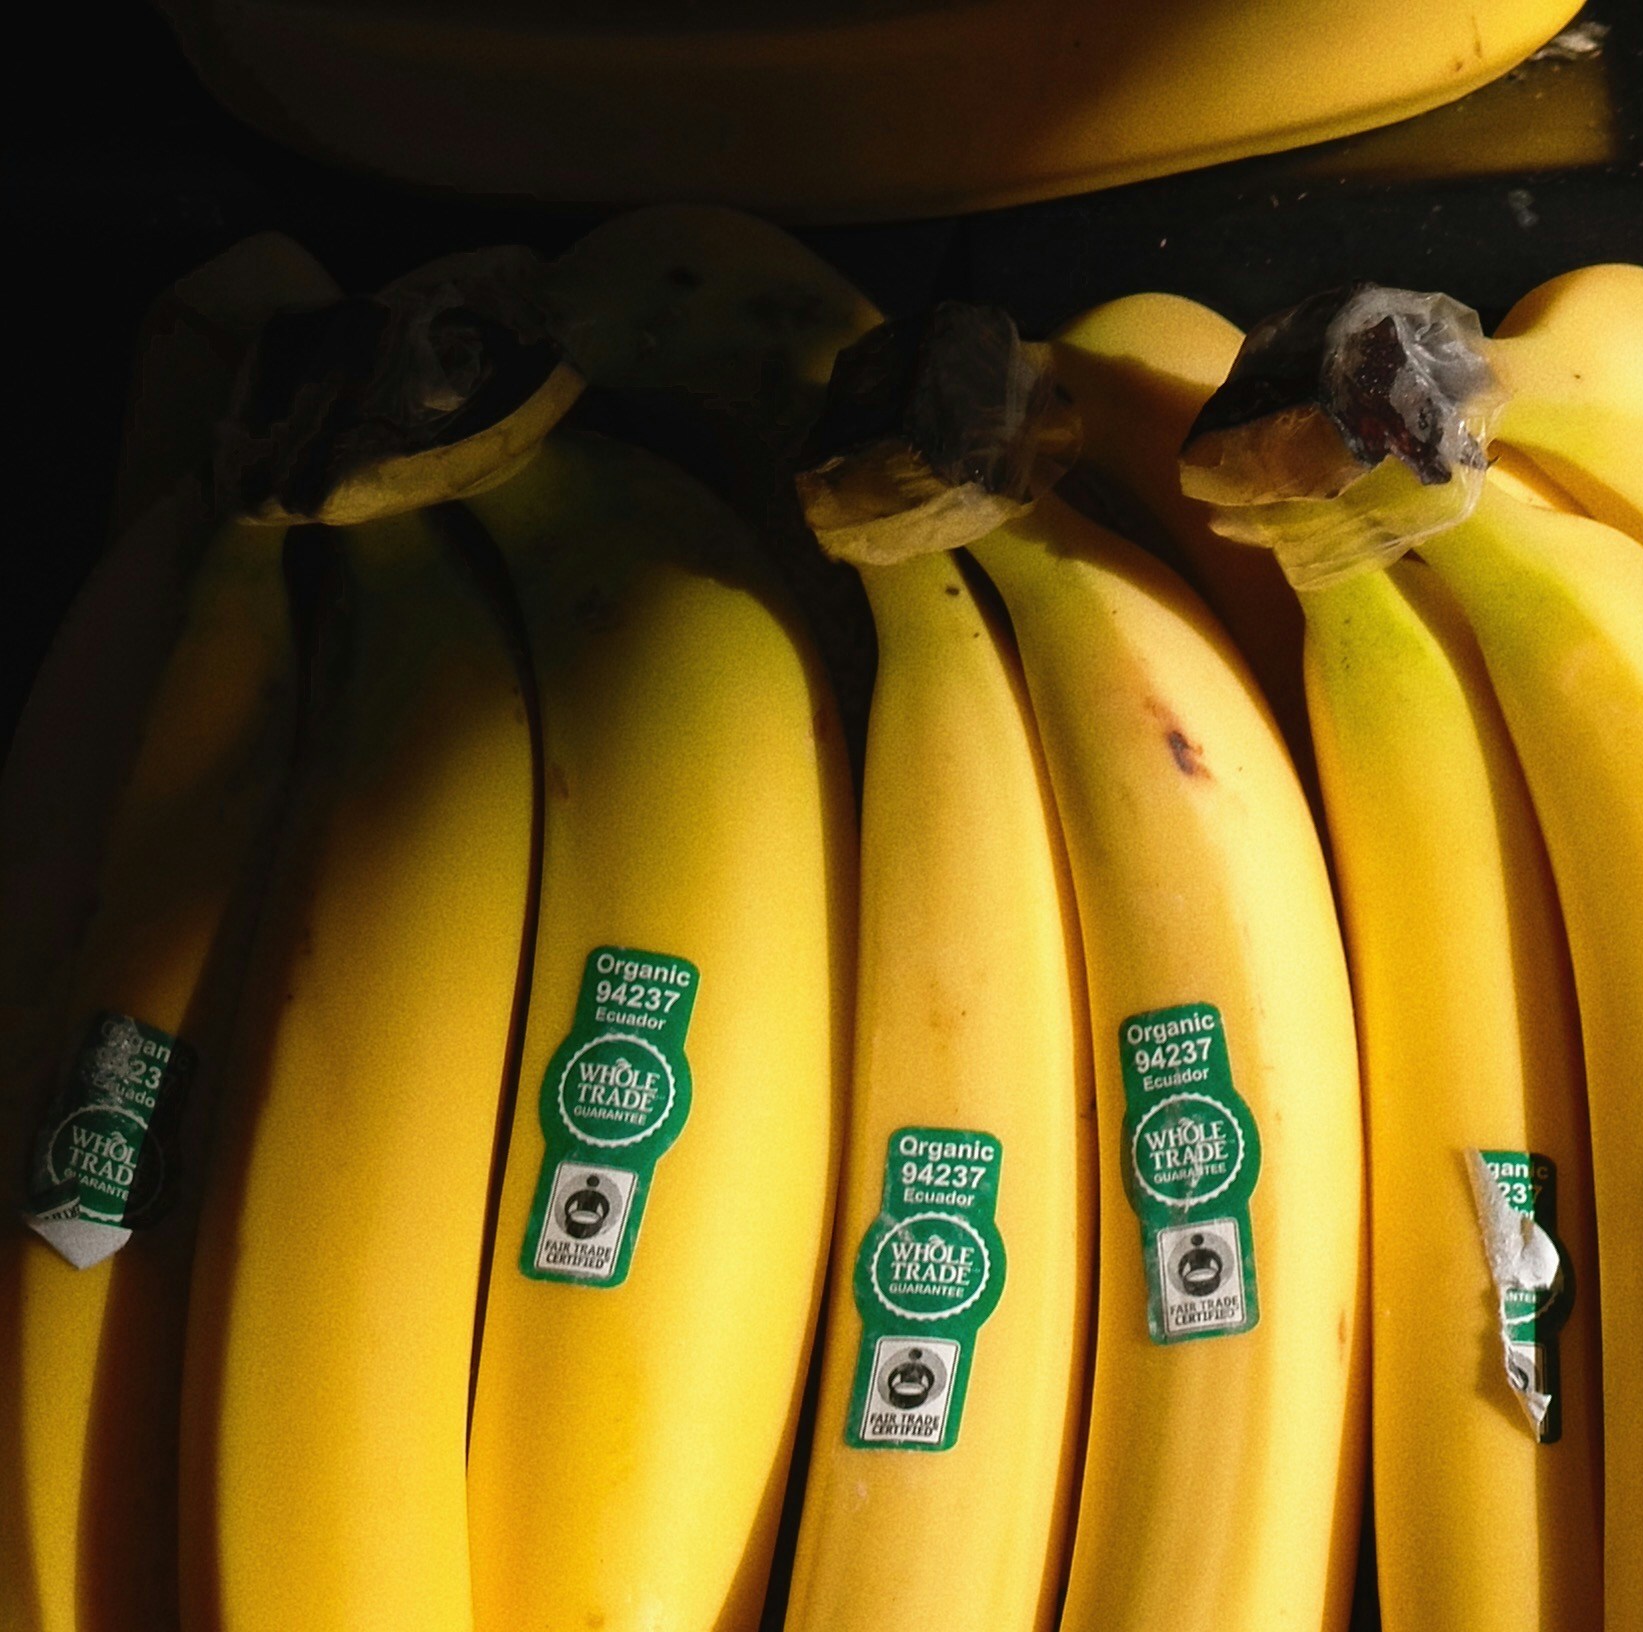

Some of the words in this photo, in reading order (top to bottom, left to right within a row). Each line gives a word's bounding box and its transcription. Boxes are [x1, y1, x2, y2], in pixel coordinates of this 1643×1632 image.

[597, 954, 692, 987] Organic
[596, 980, 681, 1013] 94237
[595, 1007, 666, 1031] Ecuador
[1127, 1012, 1215, 1046] Organic
[1134, 1037, 1212, 1074] 94237
[579, 1062, 660, 1092] WHOLE
[1143, 1067, 1210, 1092] Ecuador
[577, 1083, 655, 1113] TRADE
[574, 1105, 646, 1126] GUARANTEE
[71, 1124, 138, 1169] WHOL
[899, 1135, 994, 1162] Organic
[1144, 1119, 1226, 1151] WHOLE
[69, 1147, 135, 1186] TRAD
[1150, 1140, 1229, 1171] TRADE
[902, 1162, 986, 1189] 94237
[1487, 1162, 1549, 1181] ganic
[904, 1188, 975, 1207] Ecuador
[1498, 1182, 1542, 1203] 237
[544, 1239, 571, 1254] FAIR
[575, 1244, 612, 1260] TRADE
[891, 1239, 975, 1266] WHOLE
[890, 1262, 971, 1286] TRADE
[889, 1282, 964, 1298] GUARANTEE
[1170, 1300, 1197, 1316] FAIR
[1200, 1296, 1238, 1312] TRADE
[870, 1412, 897, 1425] FAIR
[900, 1414, 940, 1428] TRADE
